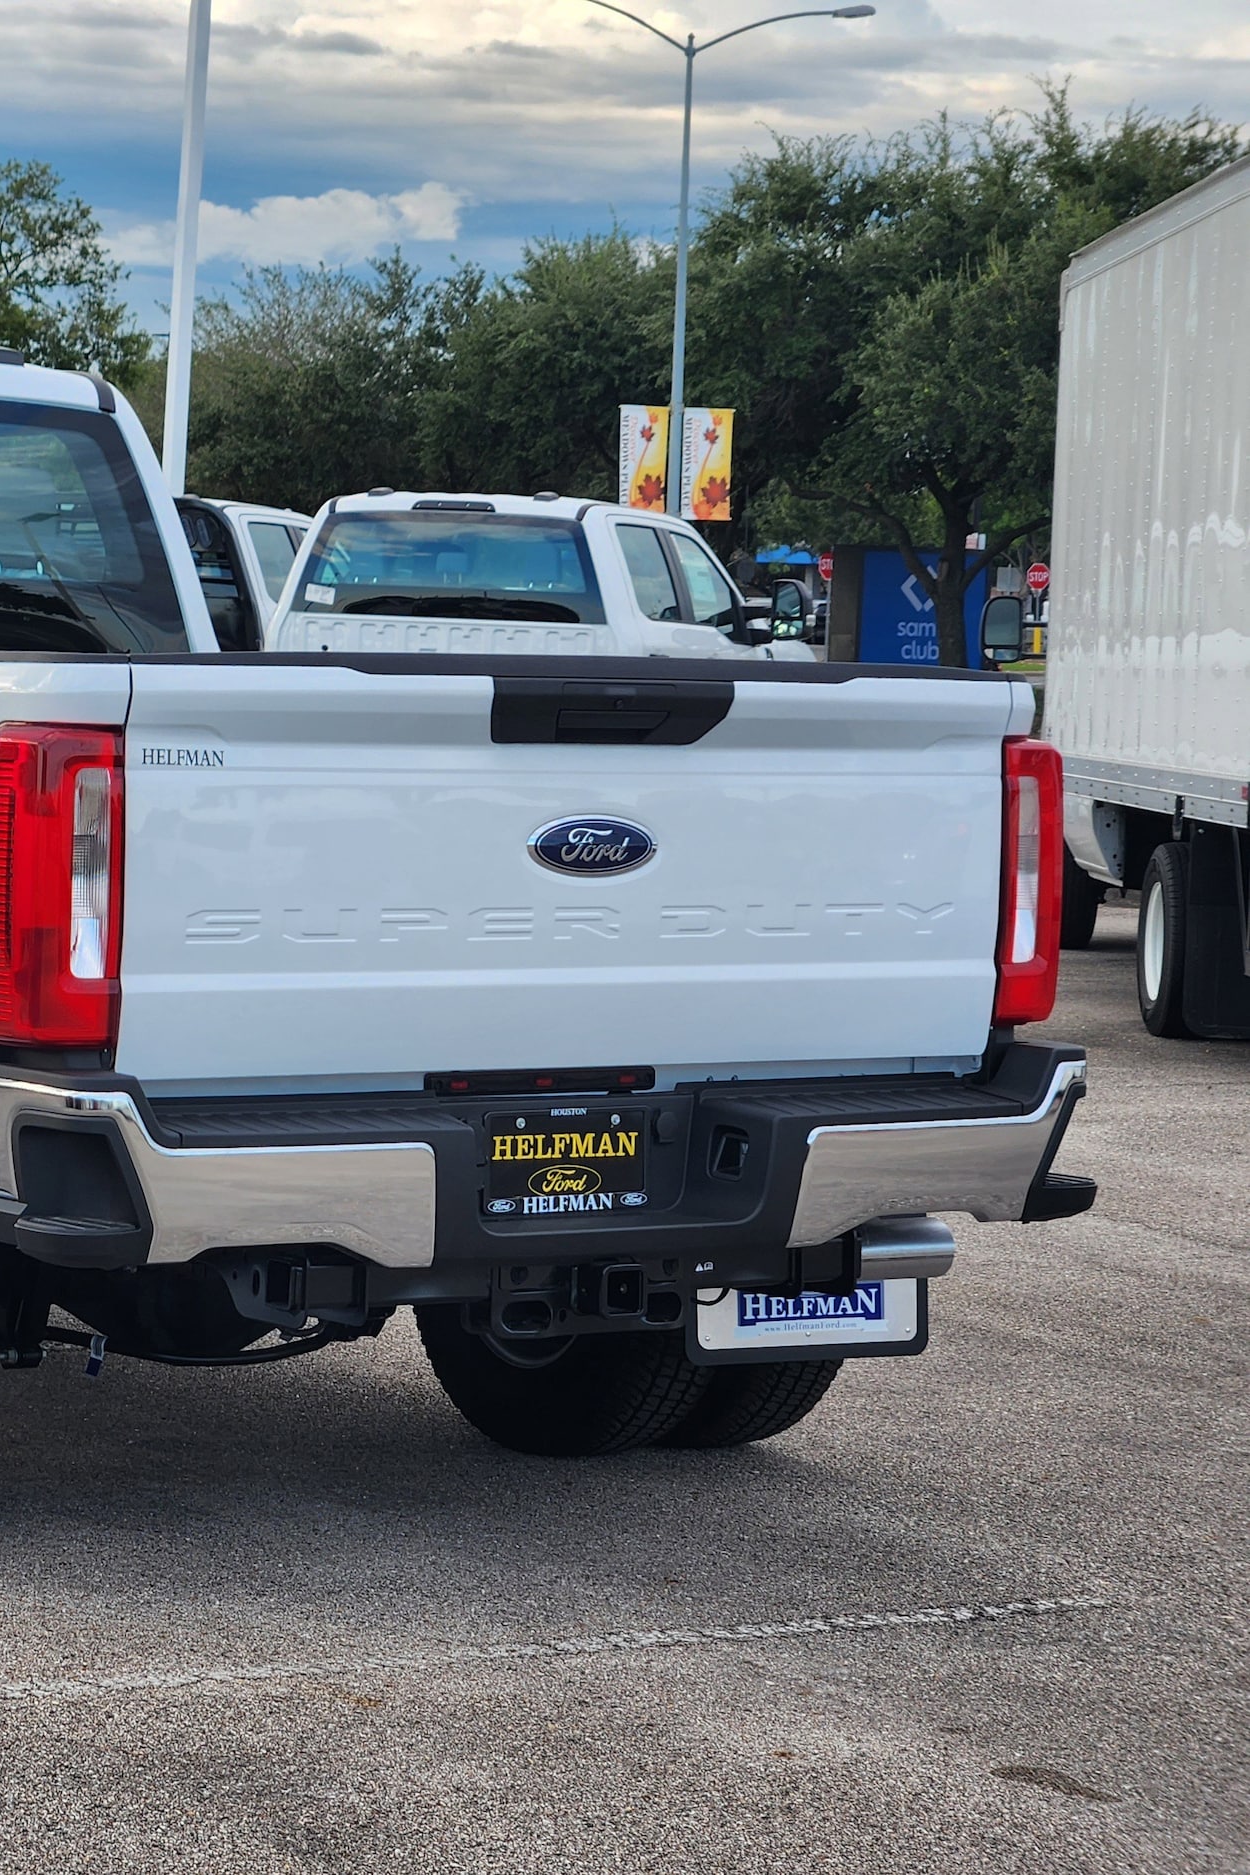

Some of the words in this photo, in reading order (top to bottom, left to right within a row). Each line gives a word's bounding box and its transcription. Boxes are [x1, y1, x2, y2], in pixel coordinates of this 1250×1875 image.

[683, 417, 693, 473] MEADOWS
[682, 475, 691, 511] PLACE
[821, 559, 834, 570] ST
[1029, 572, 1049, 582] STOP
[897, 621, 936, 637] sam
[901, 640, 940, 660] club
[142, 748, 224, 767] HELFMAN
[561, 828, 630, 862] Ford
[185, 908, 620, 944] SUPER
[660, 902, 954, 938] DUTY
[550, 1107, 587, 1116] HOUSTON
[492, 1132, 638, 1161] HELFMAN
[542, 1168, 587, 1193] Ford
[522, 1193, 614, 1214] HELFMAN
[742, 1288, 878, 1320] HELFMAN
